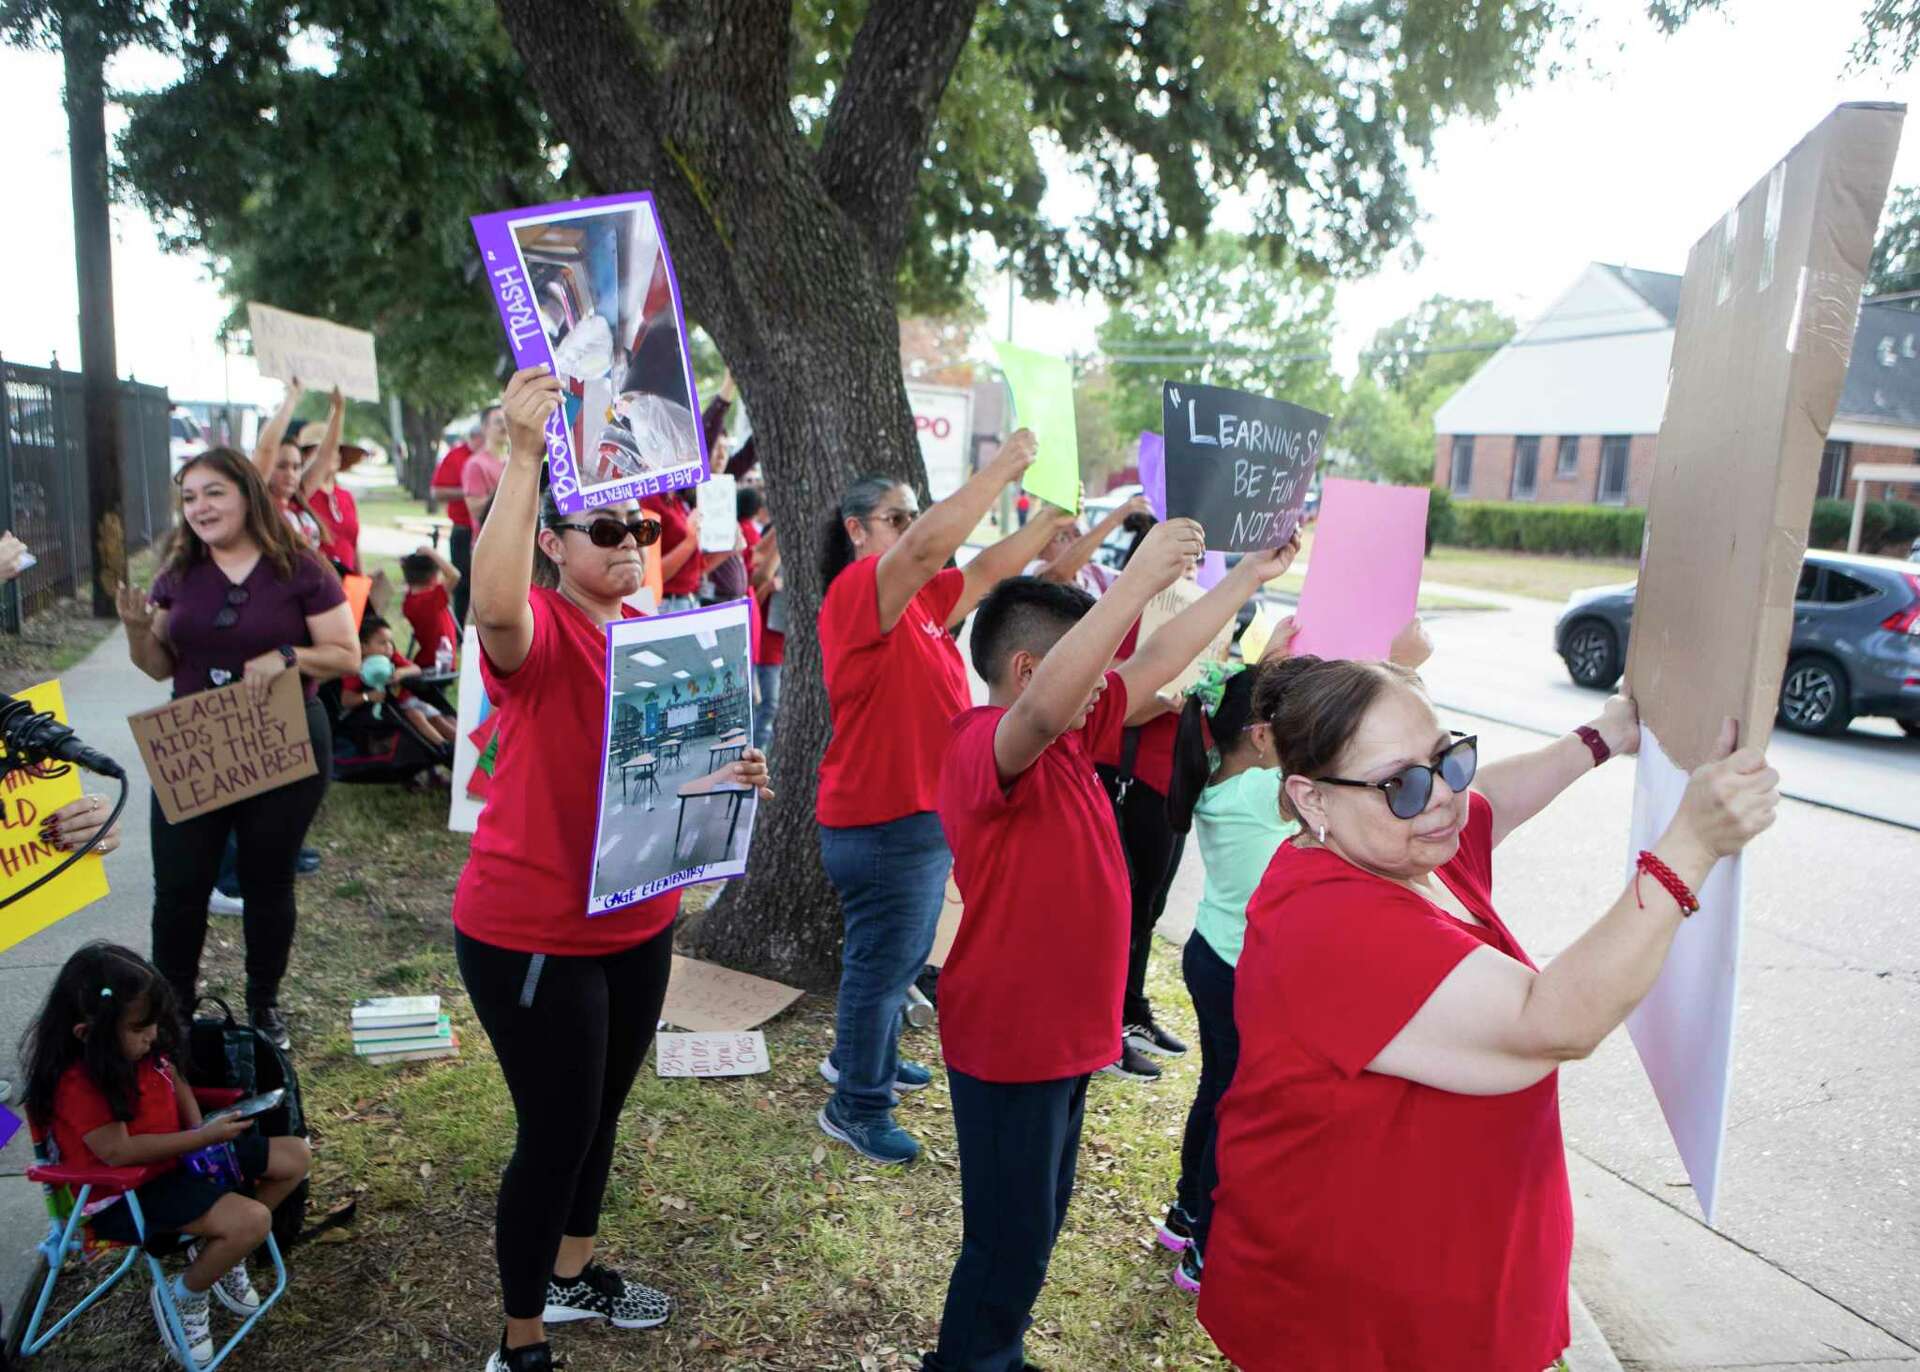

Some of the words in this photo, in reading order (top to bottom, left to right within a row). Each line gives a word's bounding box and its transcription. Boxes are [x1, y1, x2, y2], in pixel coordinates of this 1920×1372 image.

[666, 466, 704, 490] CAGE
[1233, 459, 1266, 498] BE
[1230, 511, 1273, 547] NOT
[144, 690, 239, 735] TEACH
[150, 724, 212, 762] KIDS
[215, 703, 277, 738] THE
[159, 747, 217, 785] WAY
[224, 722, 288, 762] THEY
[171, 761, 259, 813] LEARN
[261, 740, 310, 779] BEST
